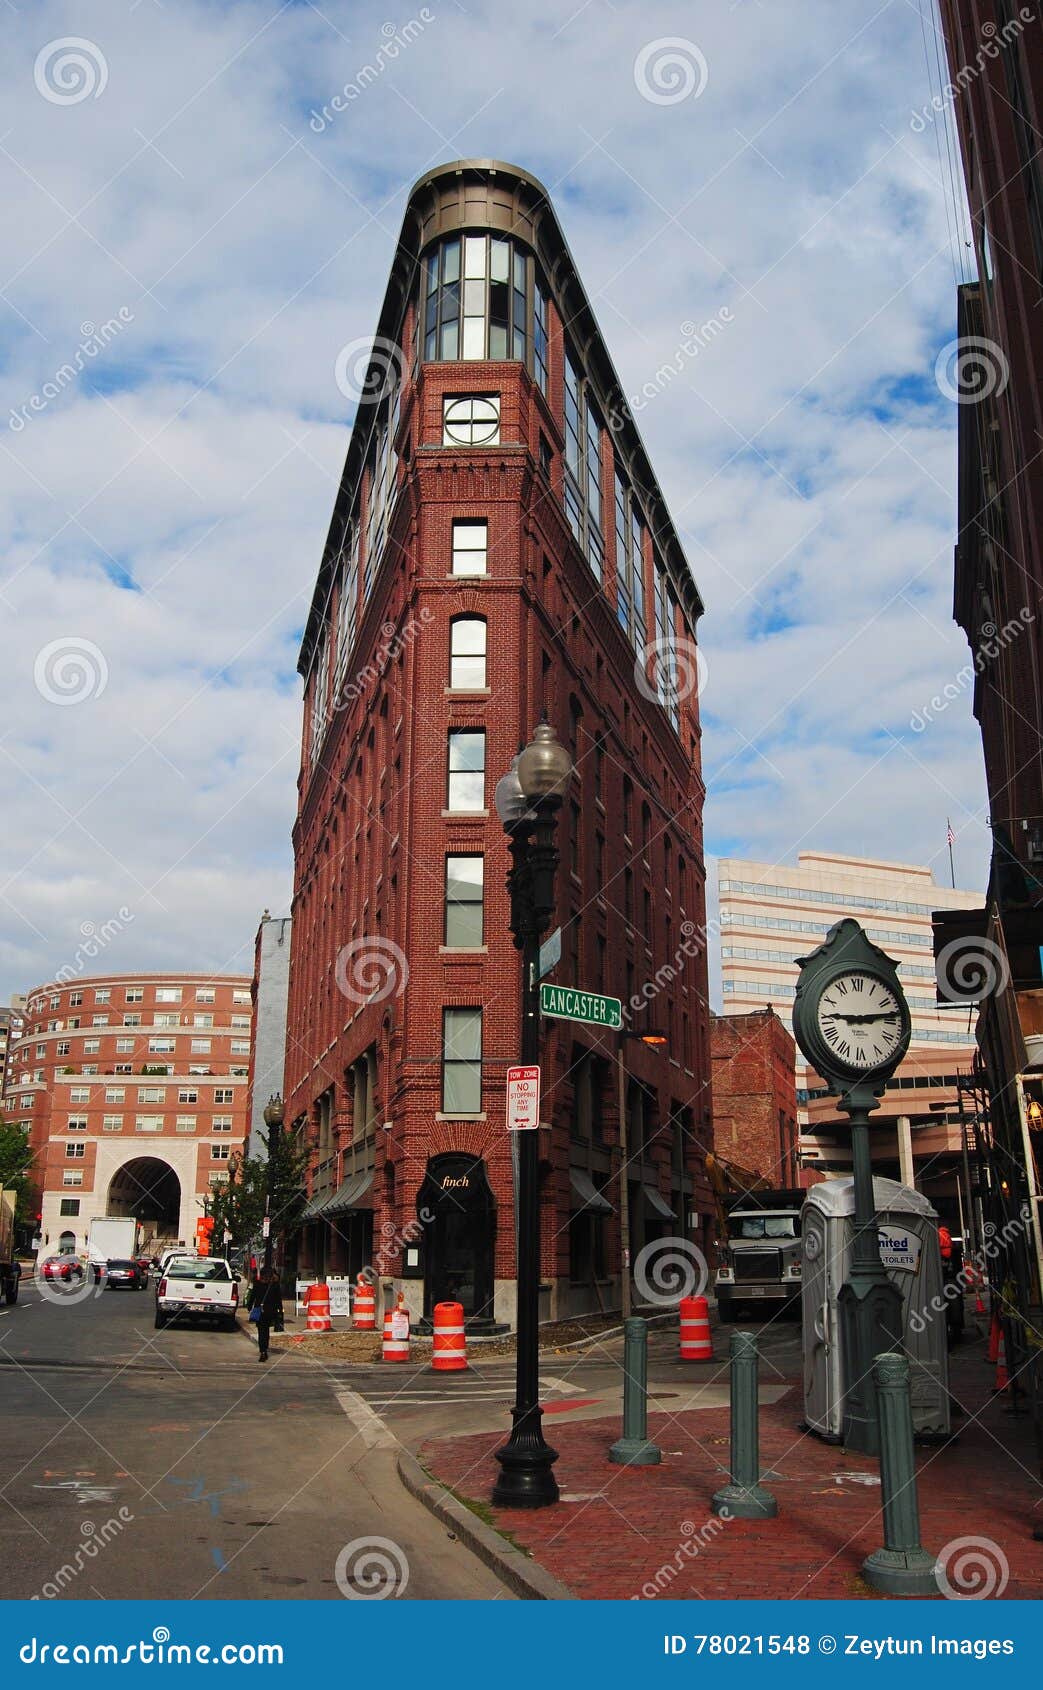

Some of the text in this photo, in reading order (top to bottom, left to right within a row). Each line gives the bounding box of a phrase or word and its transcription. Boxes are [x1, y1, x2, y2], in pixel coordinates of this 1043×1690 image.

[851, 978, 863, 992] XII
[543, 987, 606, 1020] LANCASTER
[510, 1070, 537, 1079] TOW ZONE
[517, 1082, 529, 1091] NO
[441, 1175, 469, 1190] finch
[880, 1237, 908, 1248] nited
[881, 1256, 914, 1264] -TOILETS
